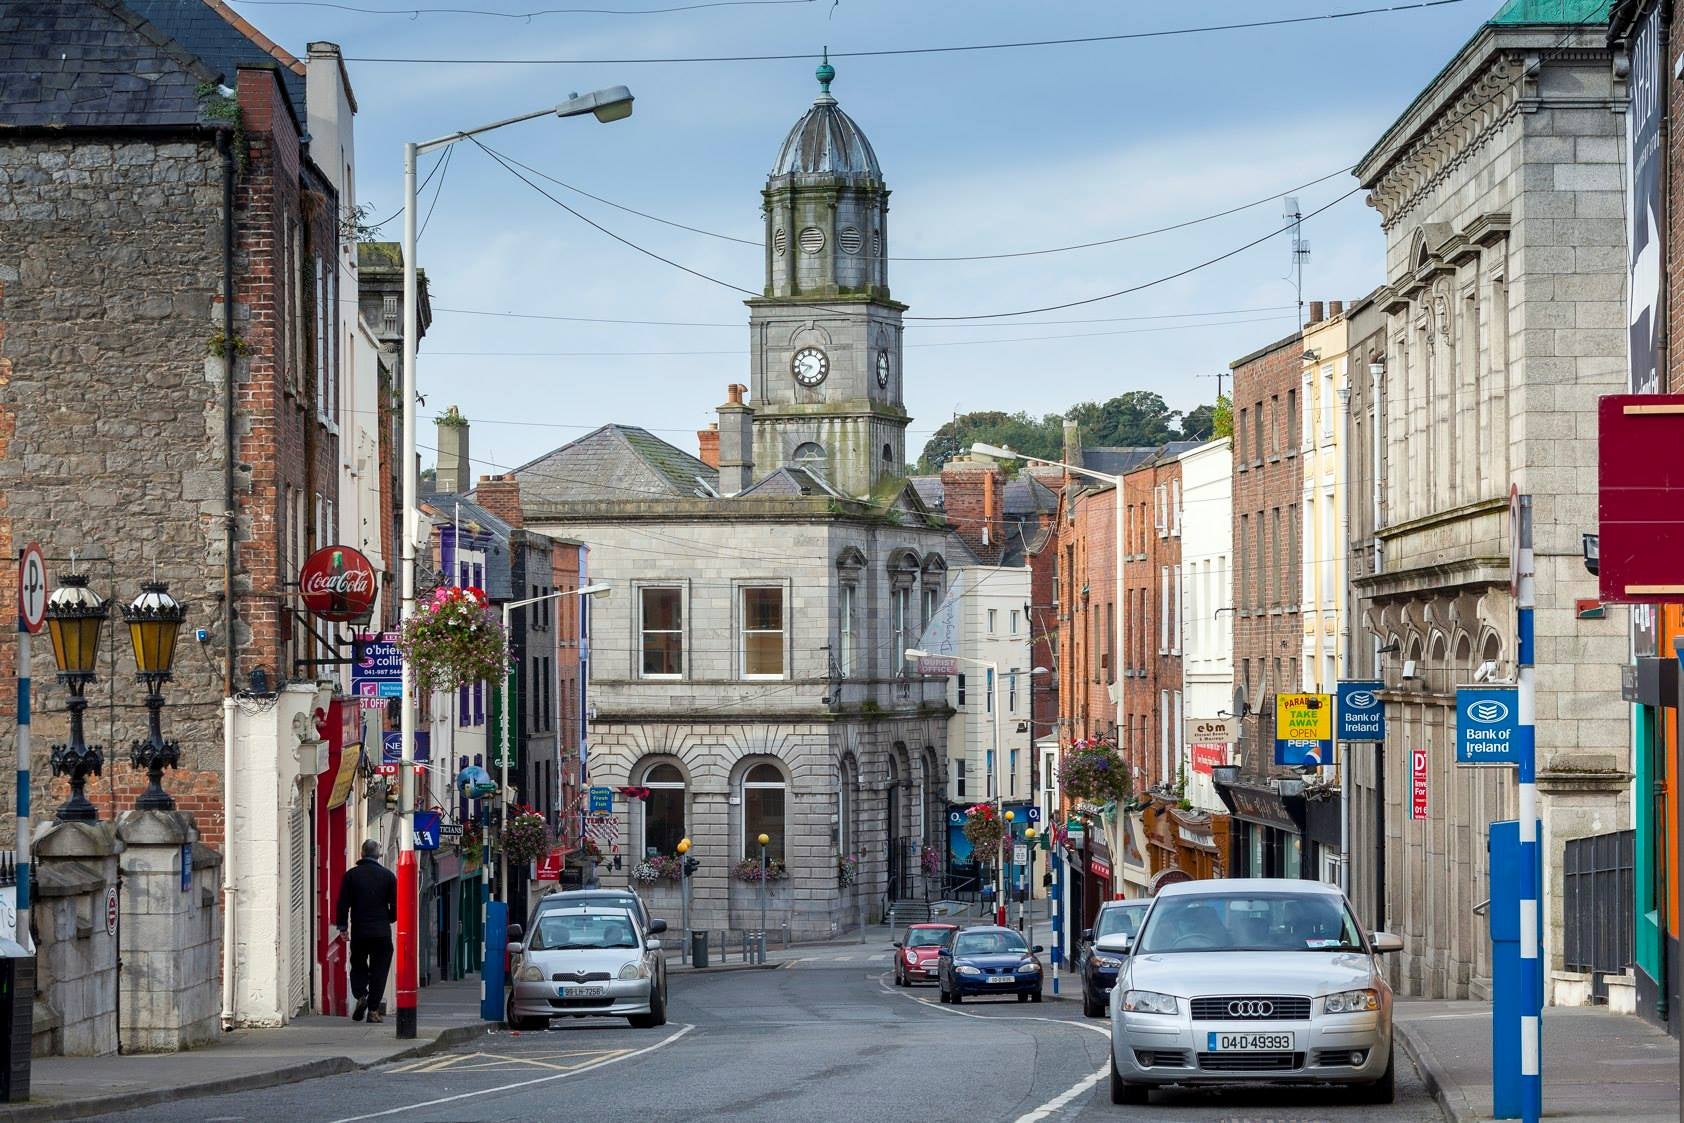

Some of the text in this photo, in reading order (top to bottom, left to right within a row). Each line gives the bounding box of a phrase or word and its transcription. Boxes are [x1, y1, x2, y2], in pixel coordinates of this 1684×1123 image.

[360, 698, 391, 708] ST OFFI
[1290, 710, 1318, 718] TAKE
[1345, 713, 1380, 722] Bank of
[1197, 722, 1226, 732] ebm
[1345, 723, 1379, 732] Ireland
[1289, 728, 1317, 738] OPEN
[1466, 728, 1512, 740] Bank of
[1287, 739, 1320, 748] PEPSI
[1466, 741, 1510, 753] Ireland
[378, 765, 396, 773] TO
[440, 826, 462, 834] TICIANS
